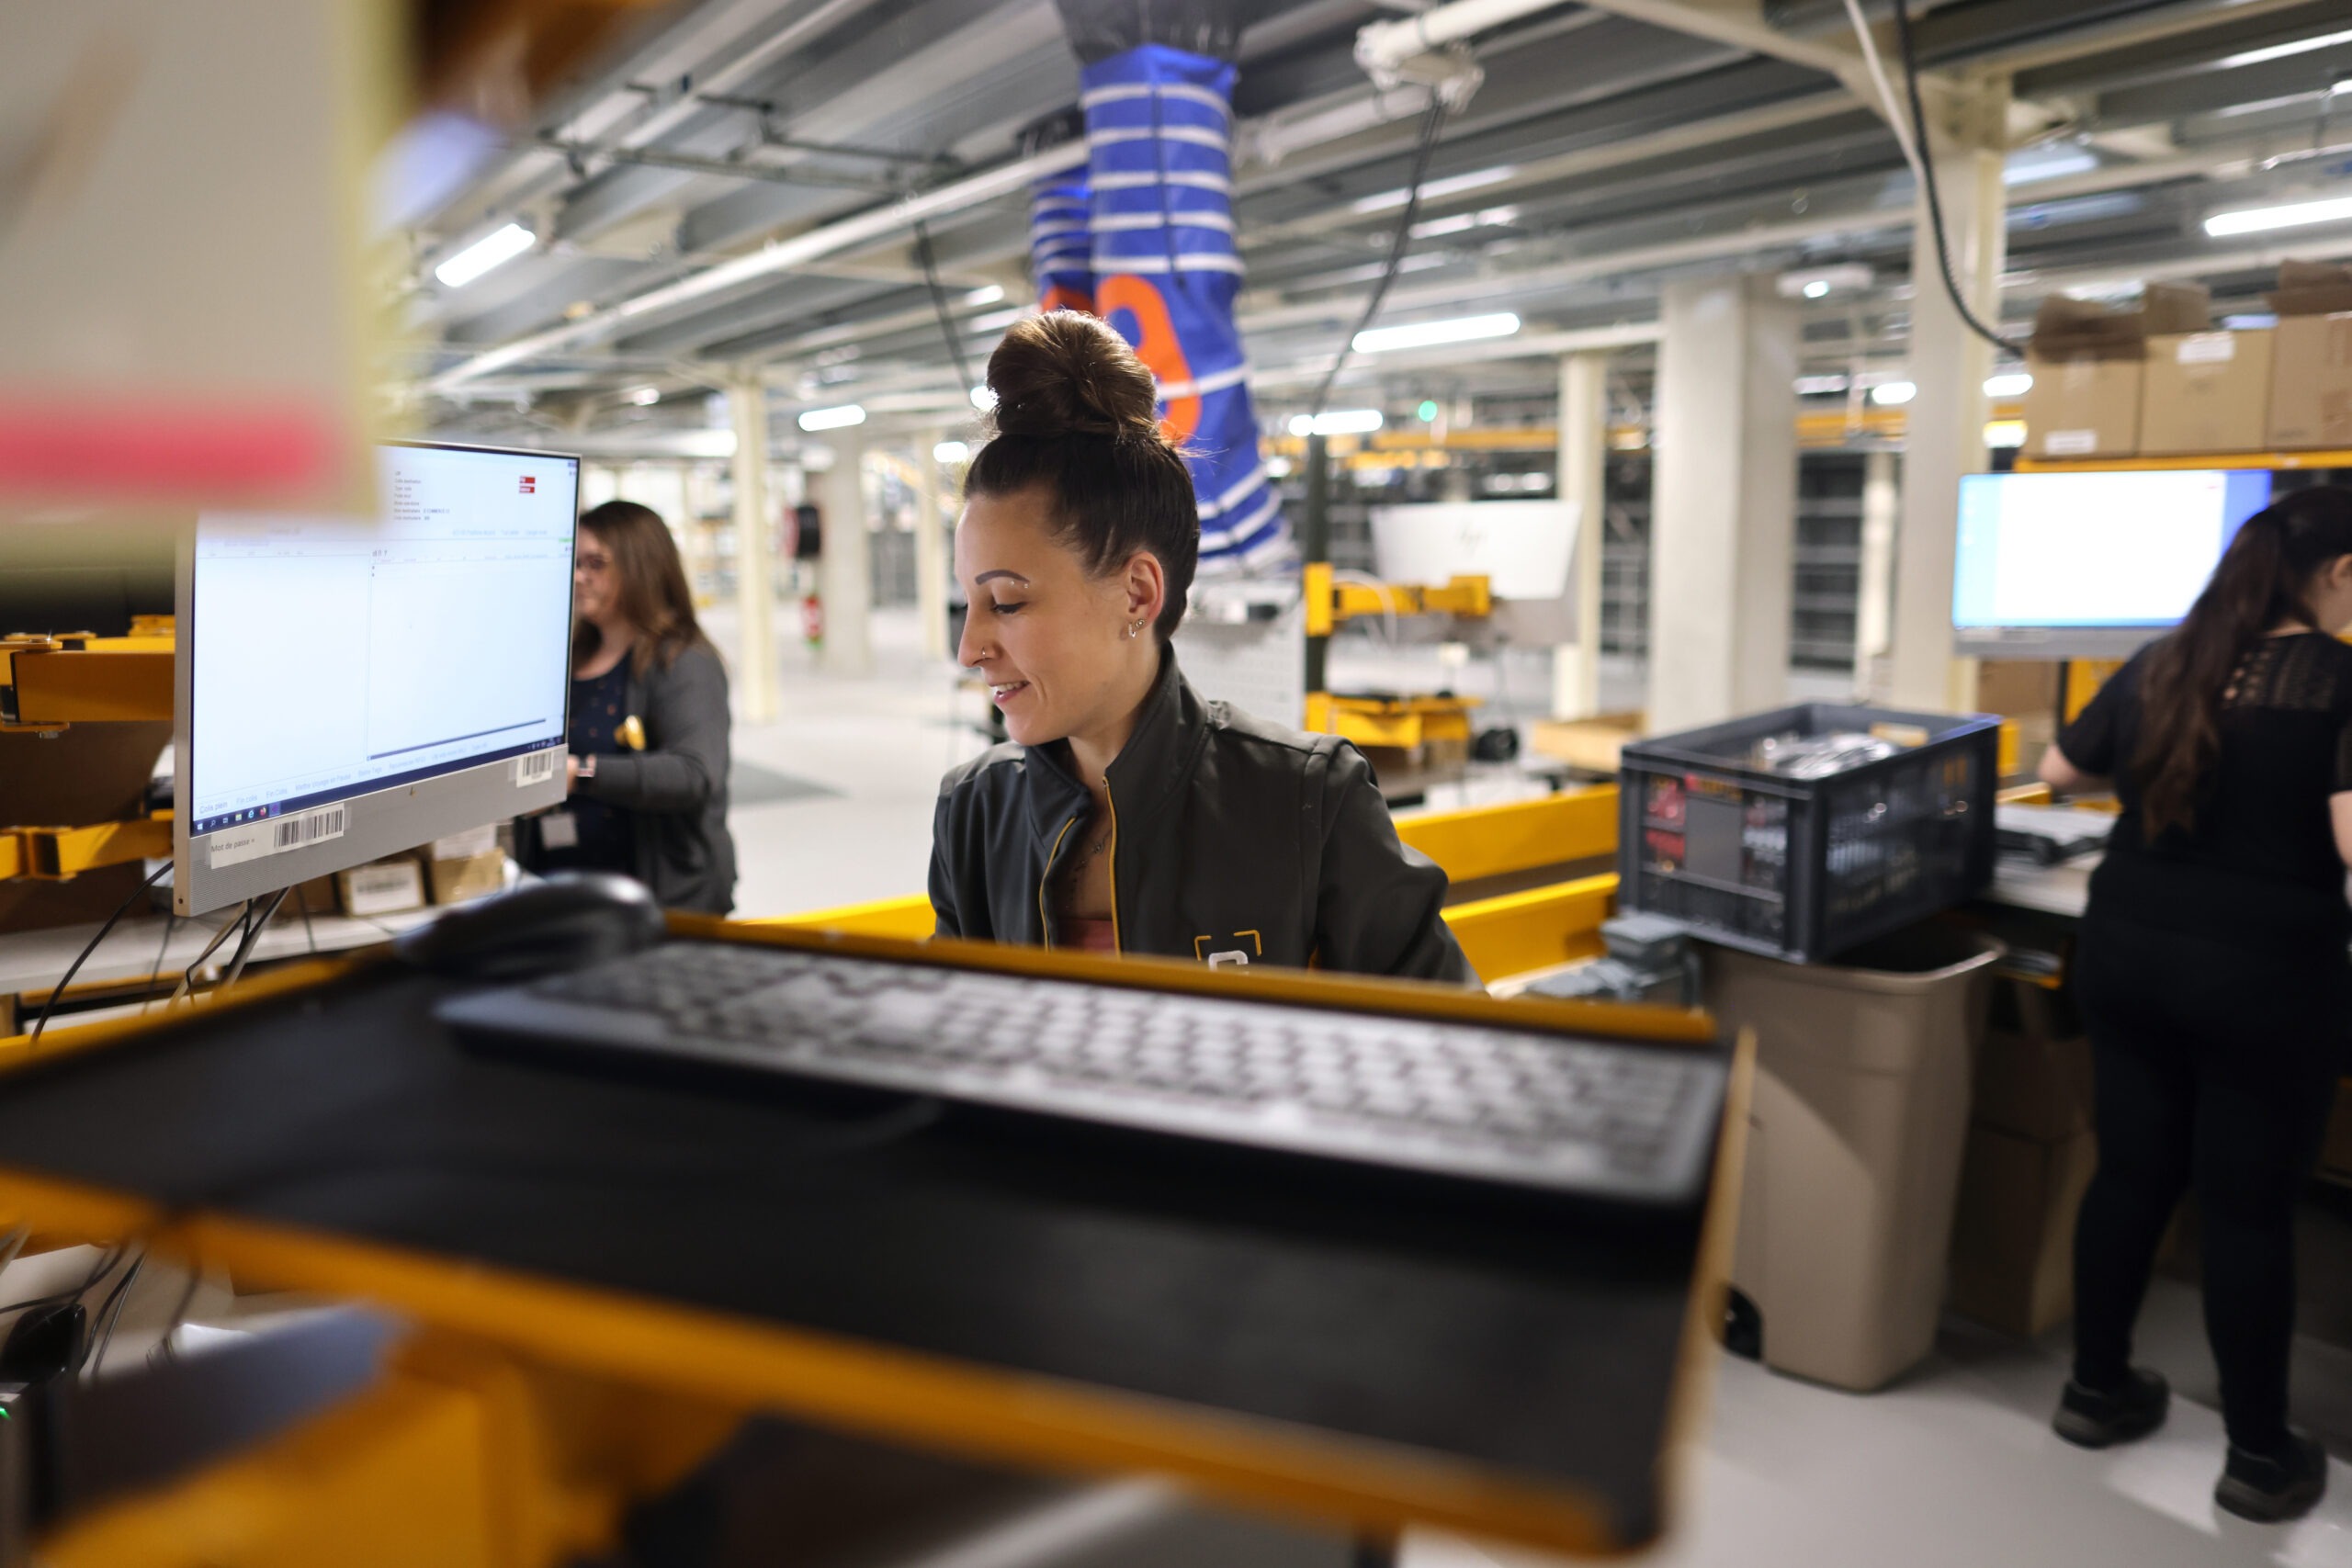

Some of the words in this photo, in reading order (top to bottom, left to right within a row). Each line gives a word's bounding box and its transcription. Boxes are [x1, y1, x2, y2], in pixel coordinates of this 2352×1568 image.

[210, 844, 224, 852] Mot
[225, 841, 232, 850] de
[233, 839, 250, 849] passe
